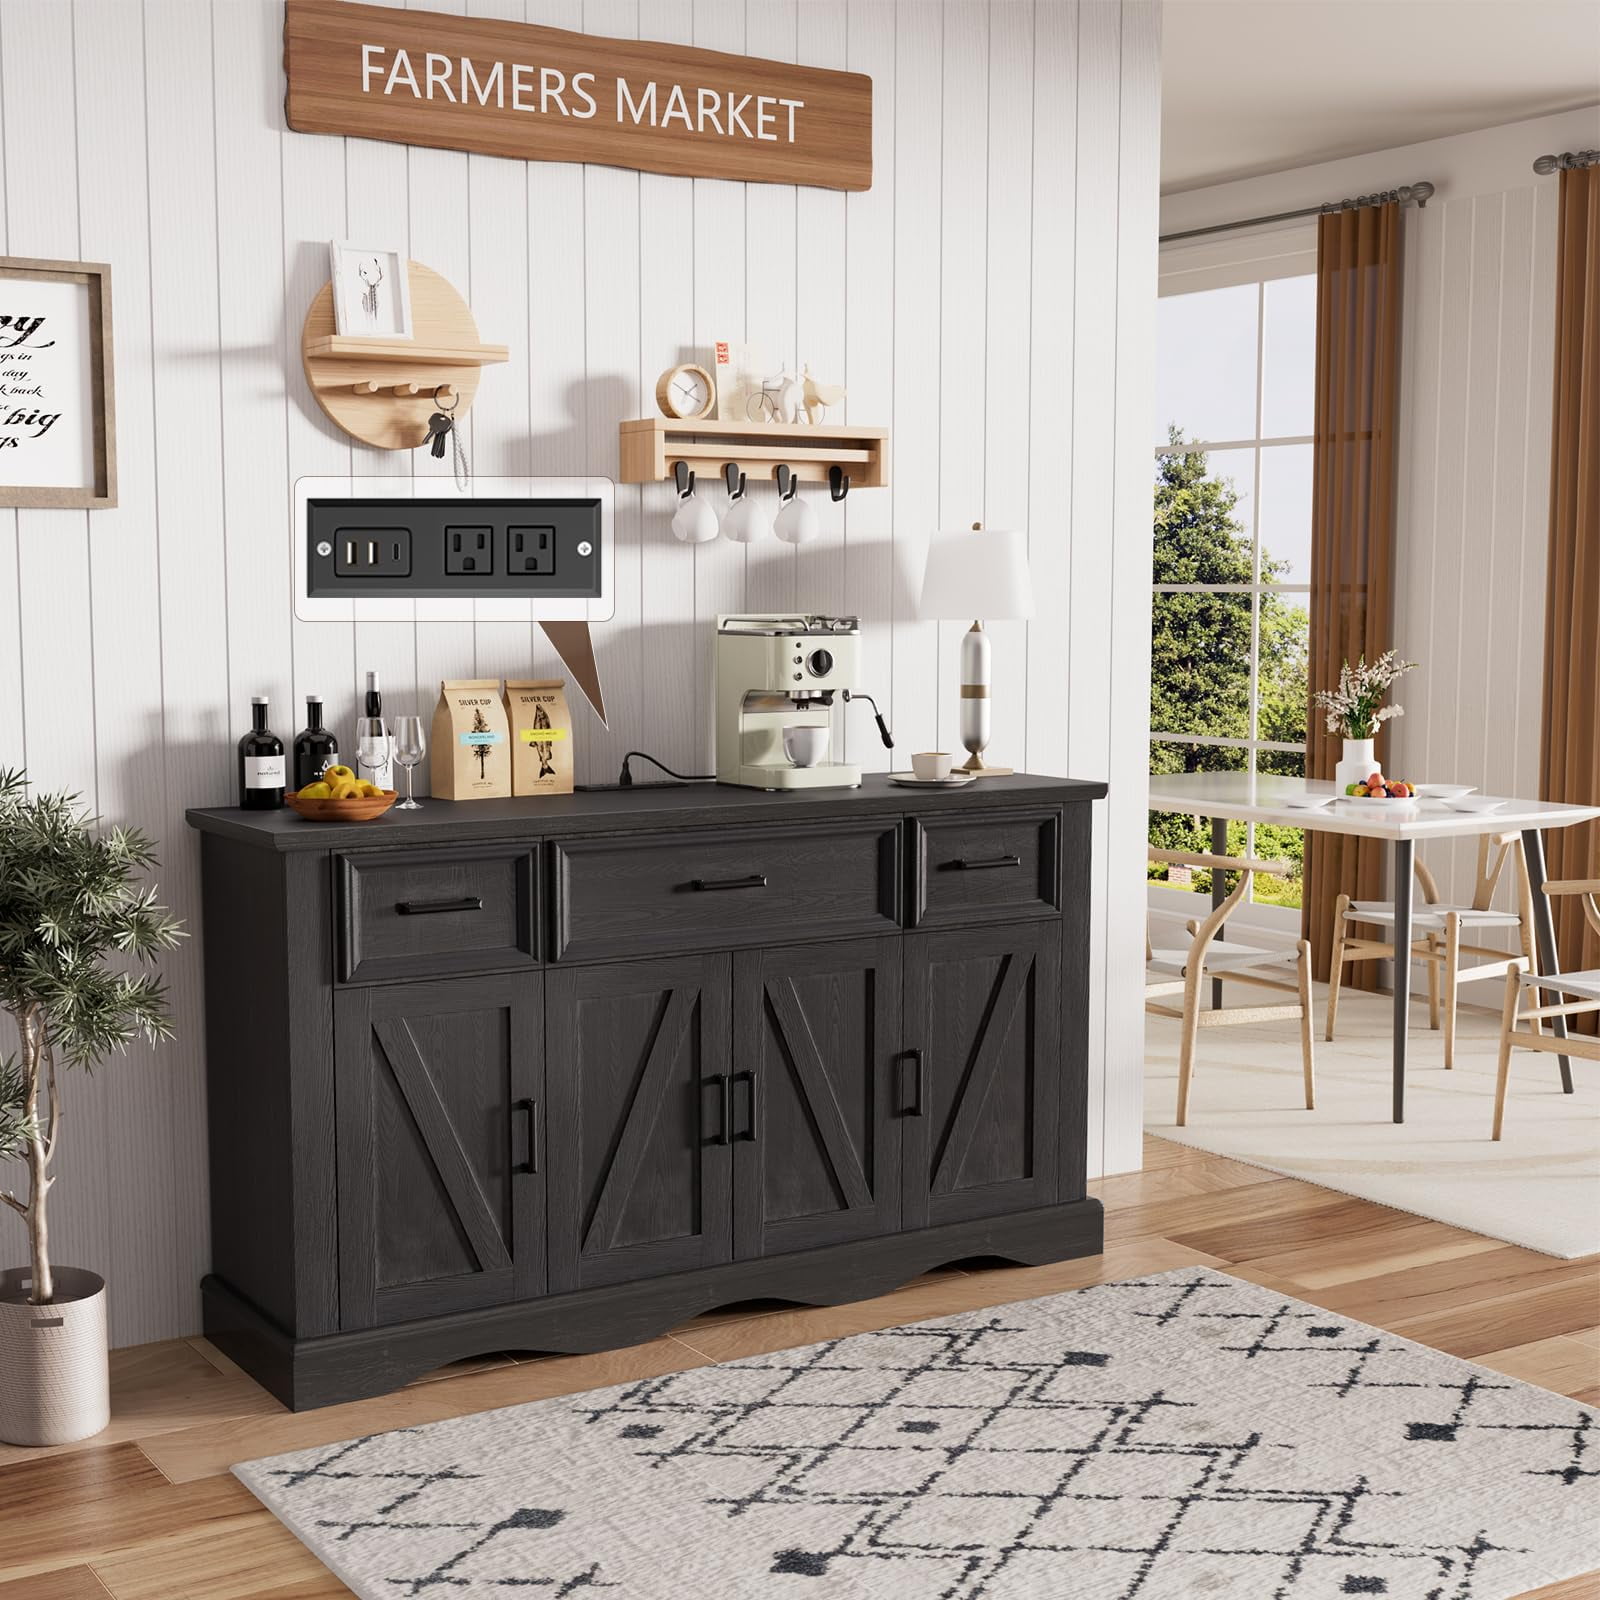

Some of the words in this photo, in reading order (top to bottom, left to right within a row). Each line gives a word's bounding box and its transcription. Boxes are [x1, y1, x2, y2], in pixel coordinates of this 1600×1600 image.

[361, 44, 597, 119] FARMERS
[616, 77, 805, 143] MARKET
[17, 352, 33, 361] in
[2, 369, 32, 382] day
[10, 385, 45, 399] back
[3, 407, 63, 439] big
